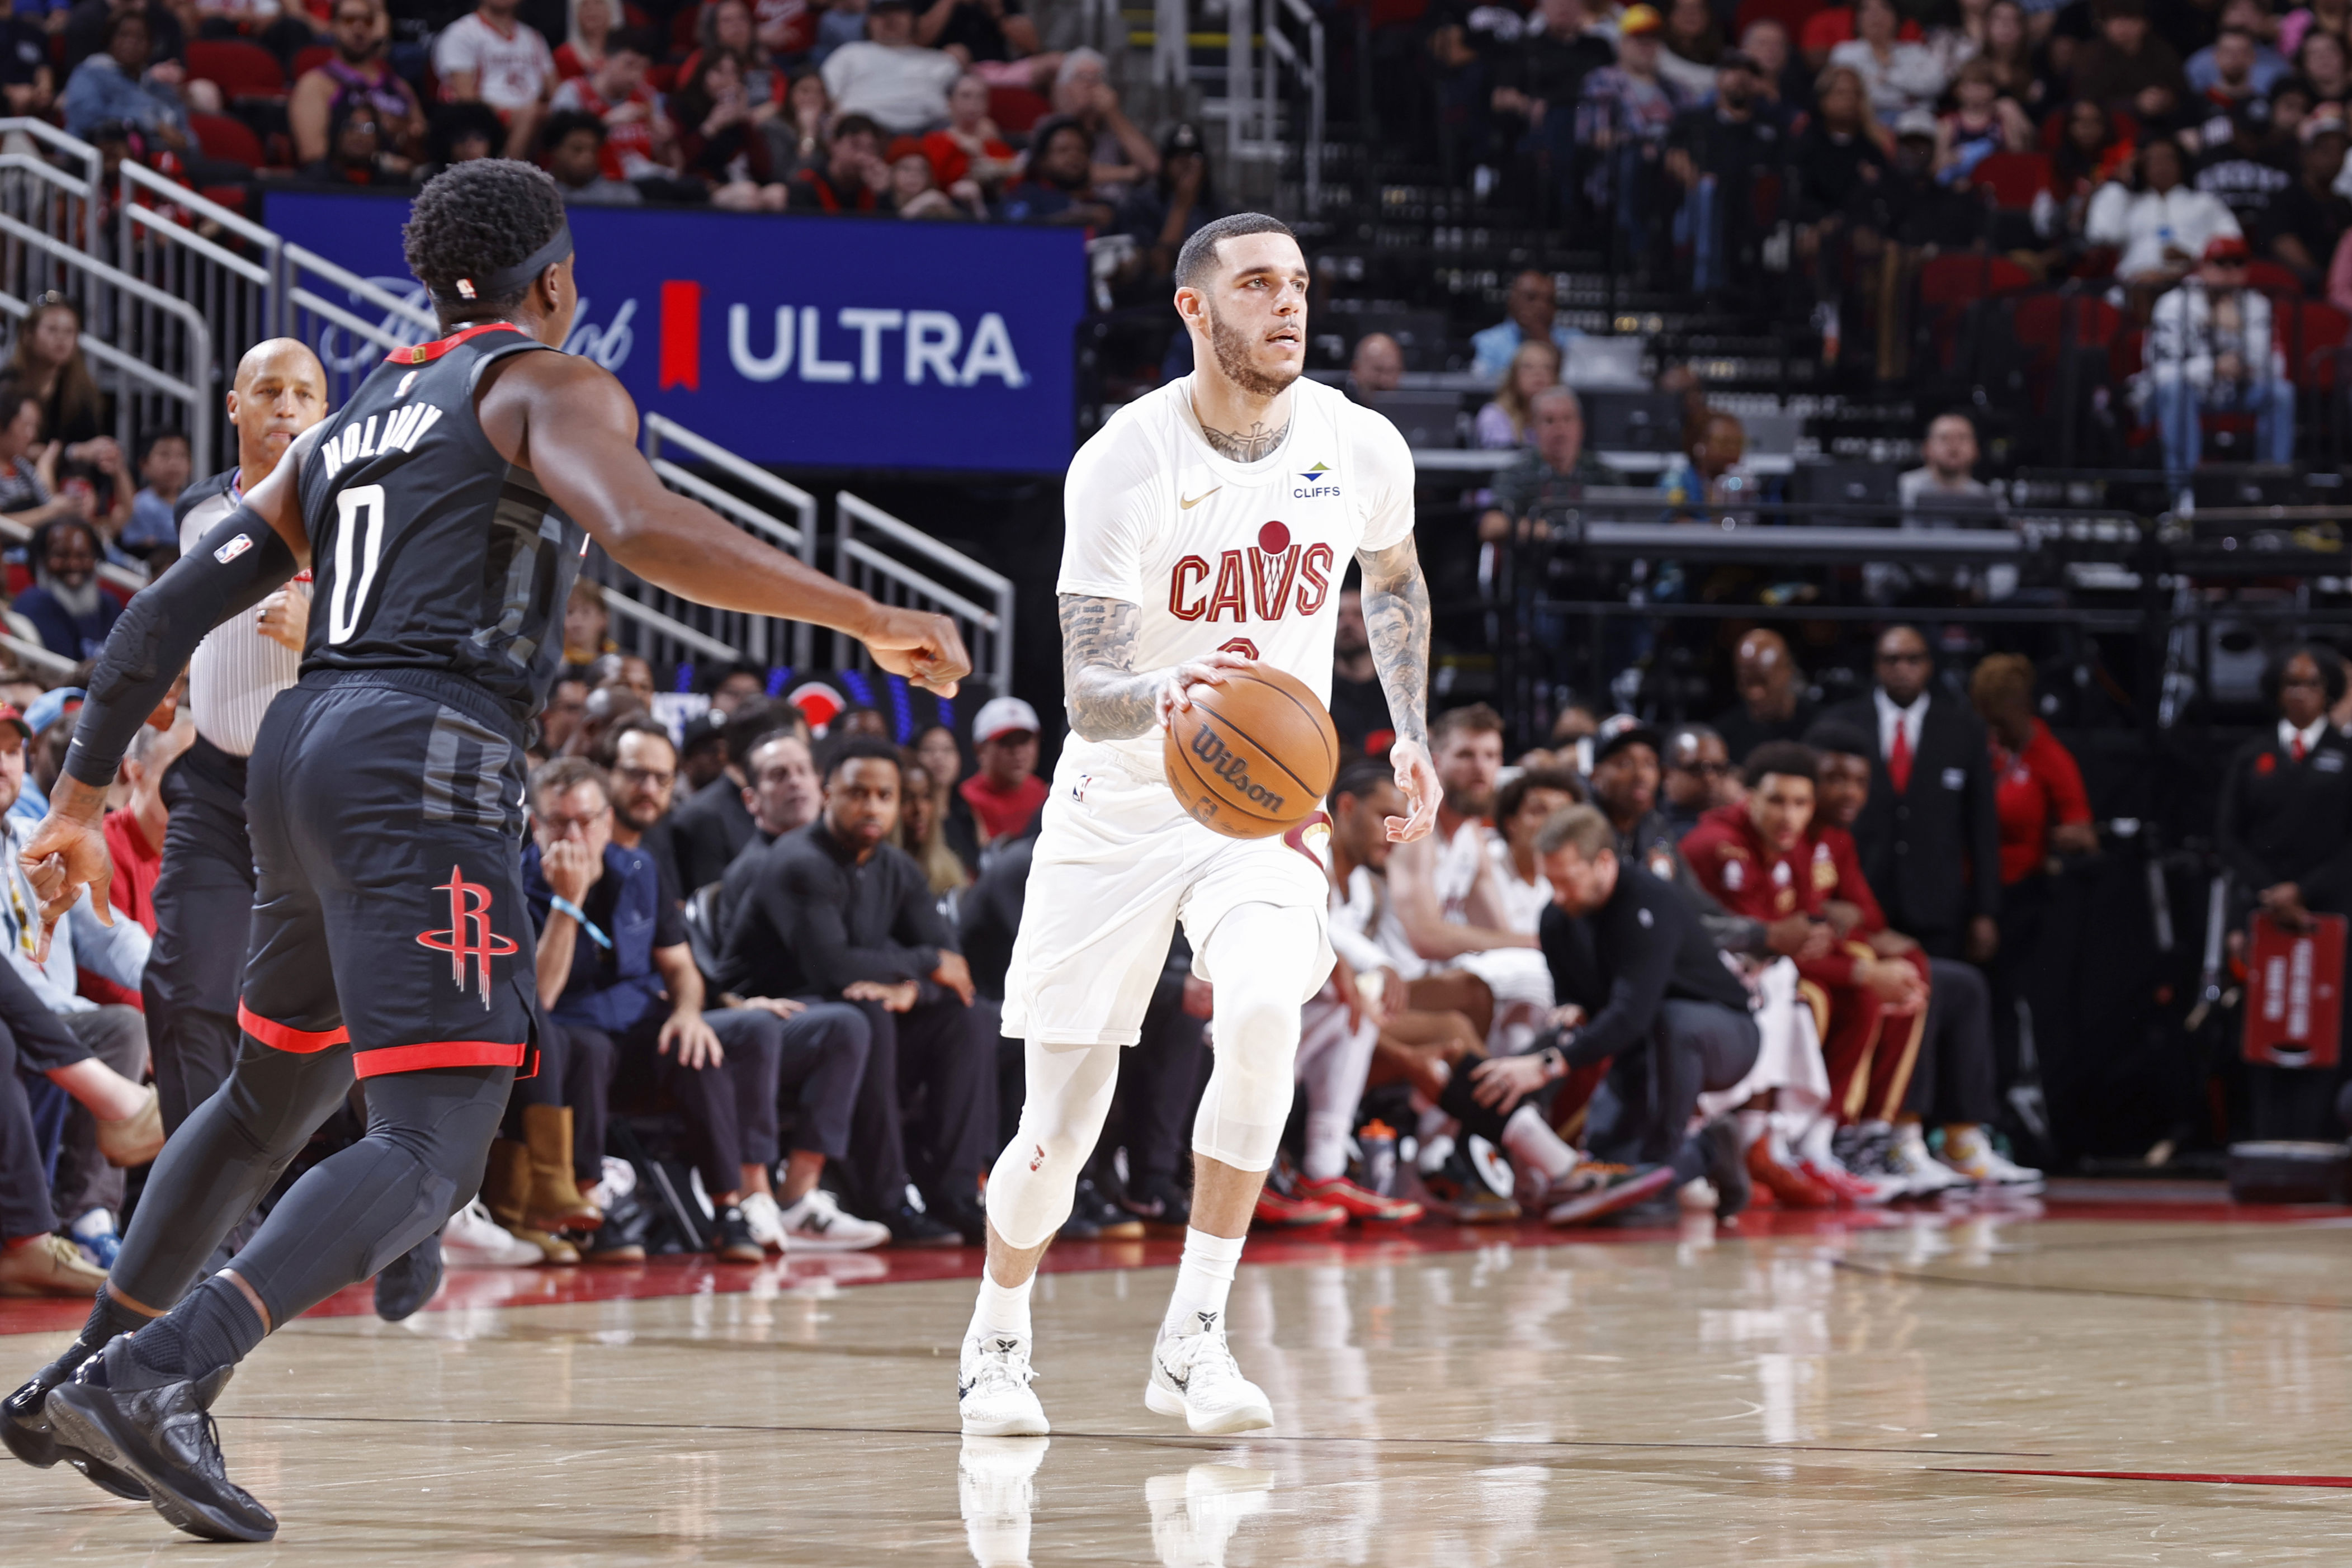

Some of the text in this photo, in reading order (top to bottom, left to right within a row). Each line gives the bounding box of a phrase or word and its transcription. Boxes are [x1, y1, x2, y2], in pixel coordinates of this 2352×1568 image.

[728, 303, 1024, 389] ULTRA
[1293, 486, 1340, 499] CLIFFS
[328, 484, 385, 645] 0
[1169, 541, 1334, 623] CAVS
[1192, 721, 1284, 814] Wilson
